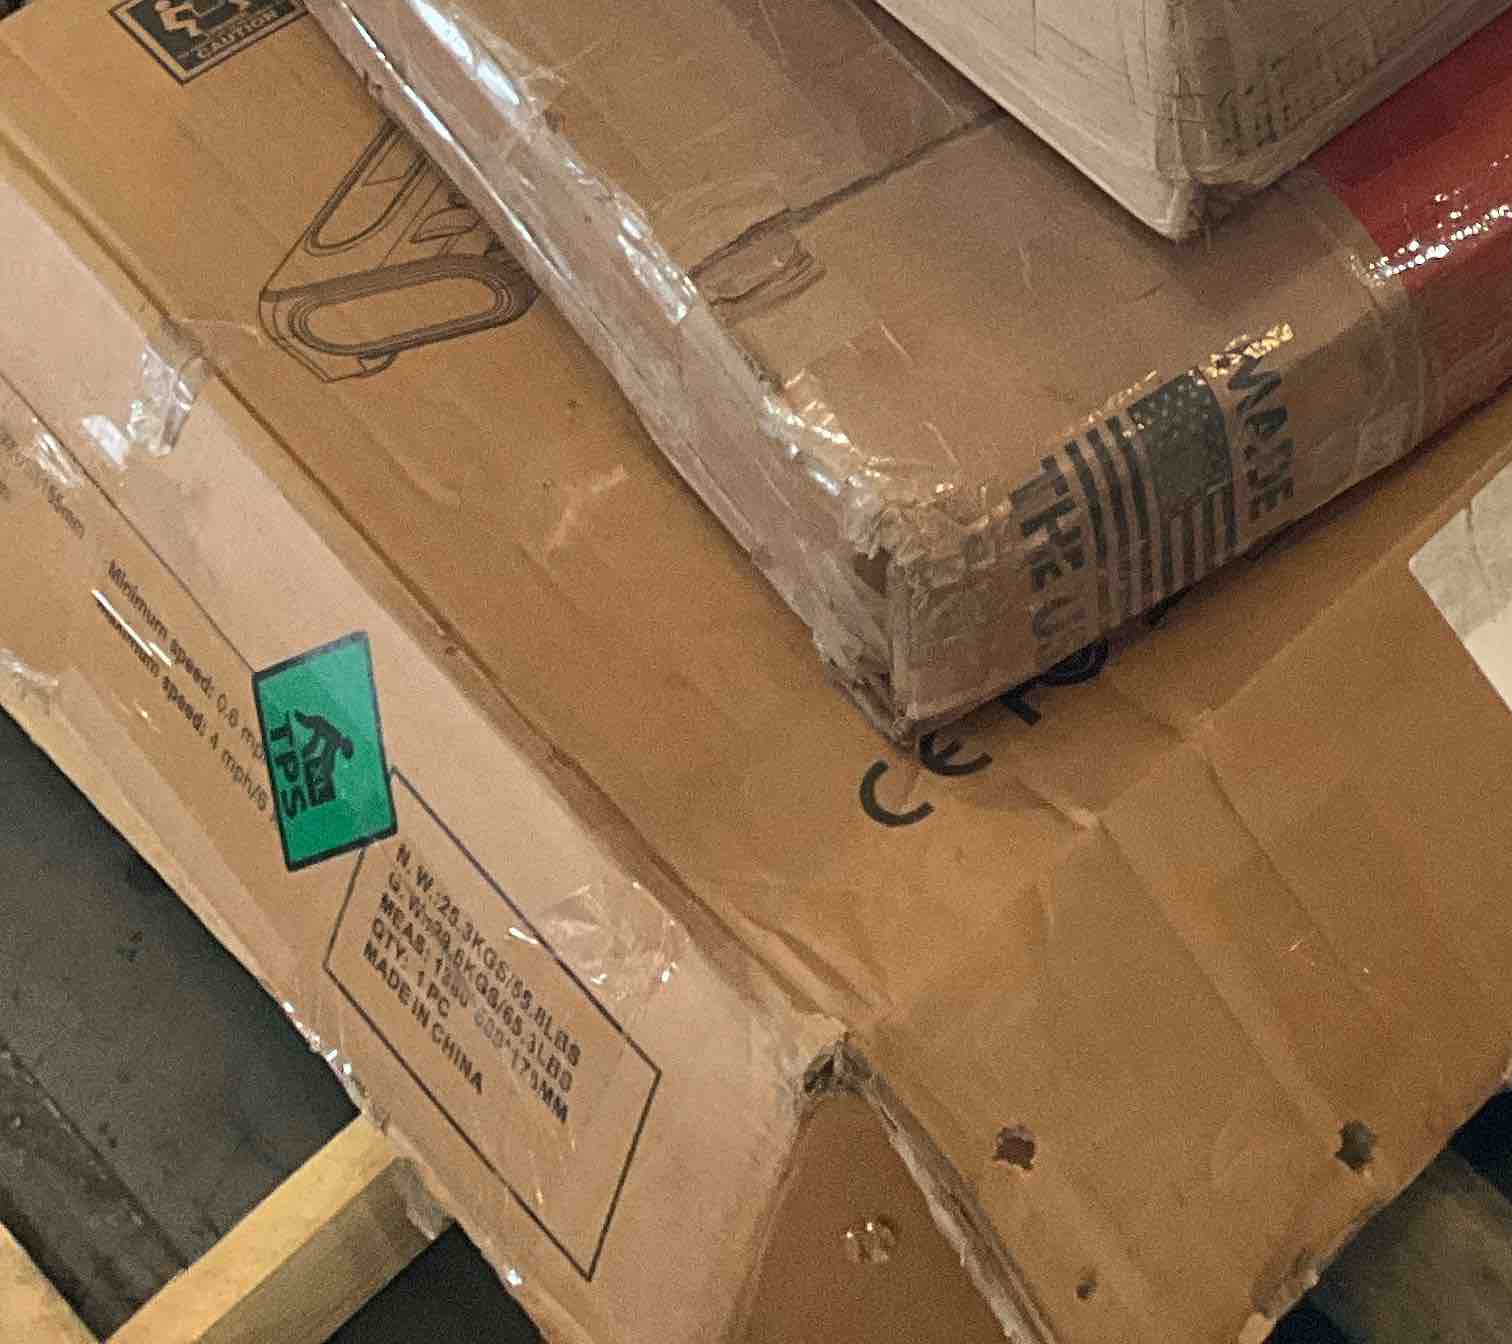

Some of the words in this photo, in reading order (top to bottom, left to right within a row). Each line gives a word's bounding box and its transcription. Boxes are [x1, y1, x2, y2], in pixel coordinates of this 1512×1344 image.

[195, 6, 276, 59] CAUTION
[1227, 355, 1296, 522] MADE
[1008, 452, 1086, 592] THE
[107, 558, 169, 642] Minimum
[168, 635, 216, 702] speed:
[160, 671, 209, 738] speed:
[269, 709, 309, 820] TPS
[371, 917, 409, 964] QTY:
[426, 981, 451, 1018] PC
[379, 891, 431, 958] MEAS:
[362, 939, 412, 1009] MADE
[411, 996, 431, 1030] IN
[430, 1020, 484, 1096] CHINA
